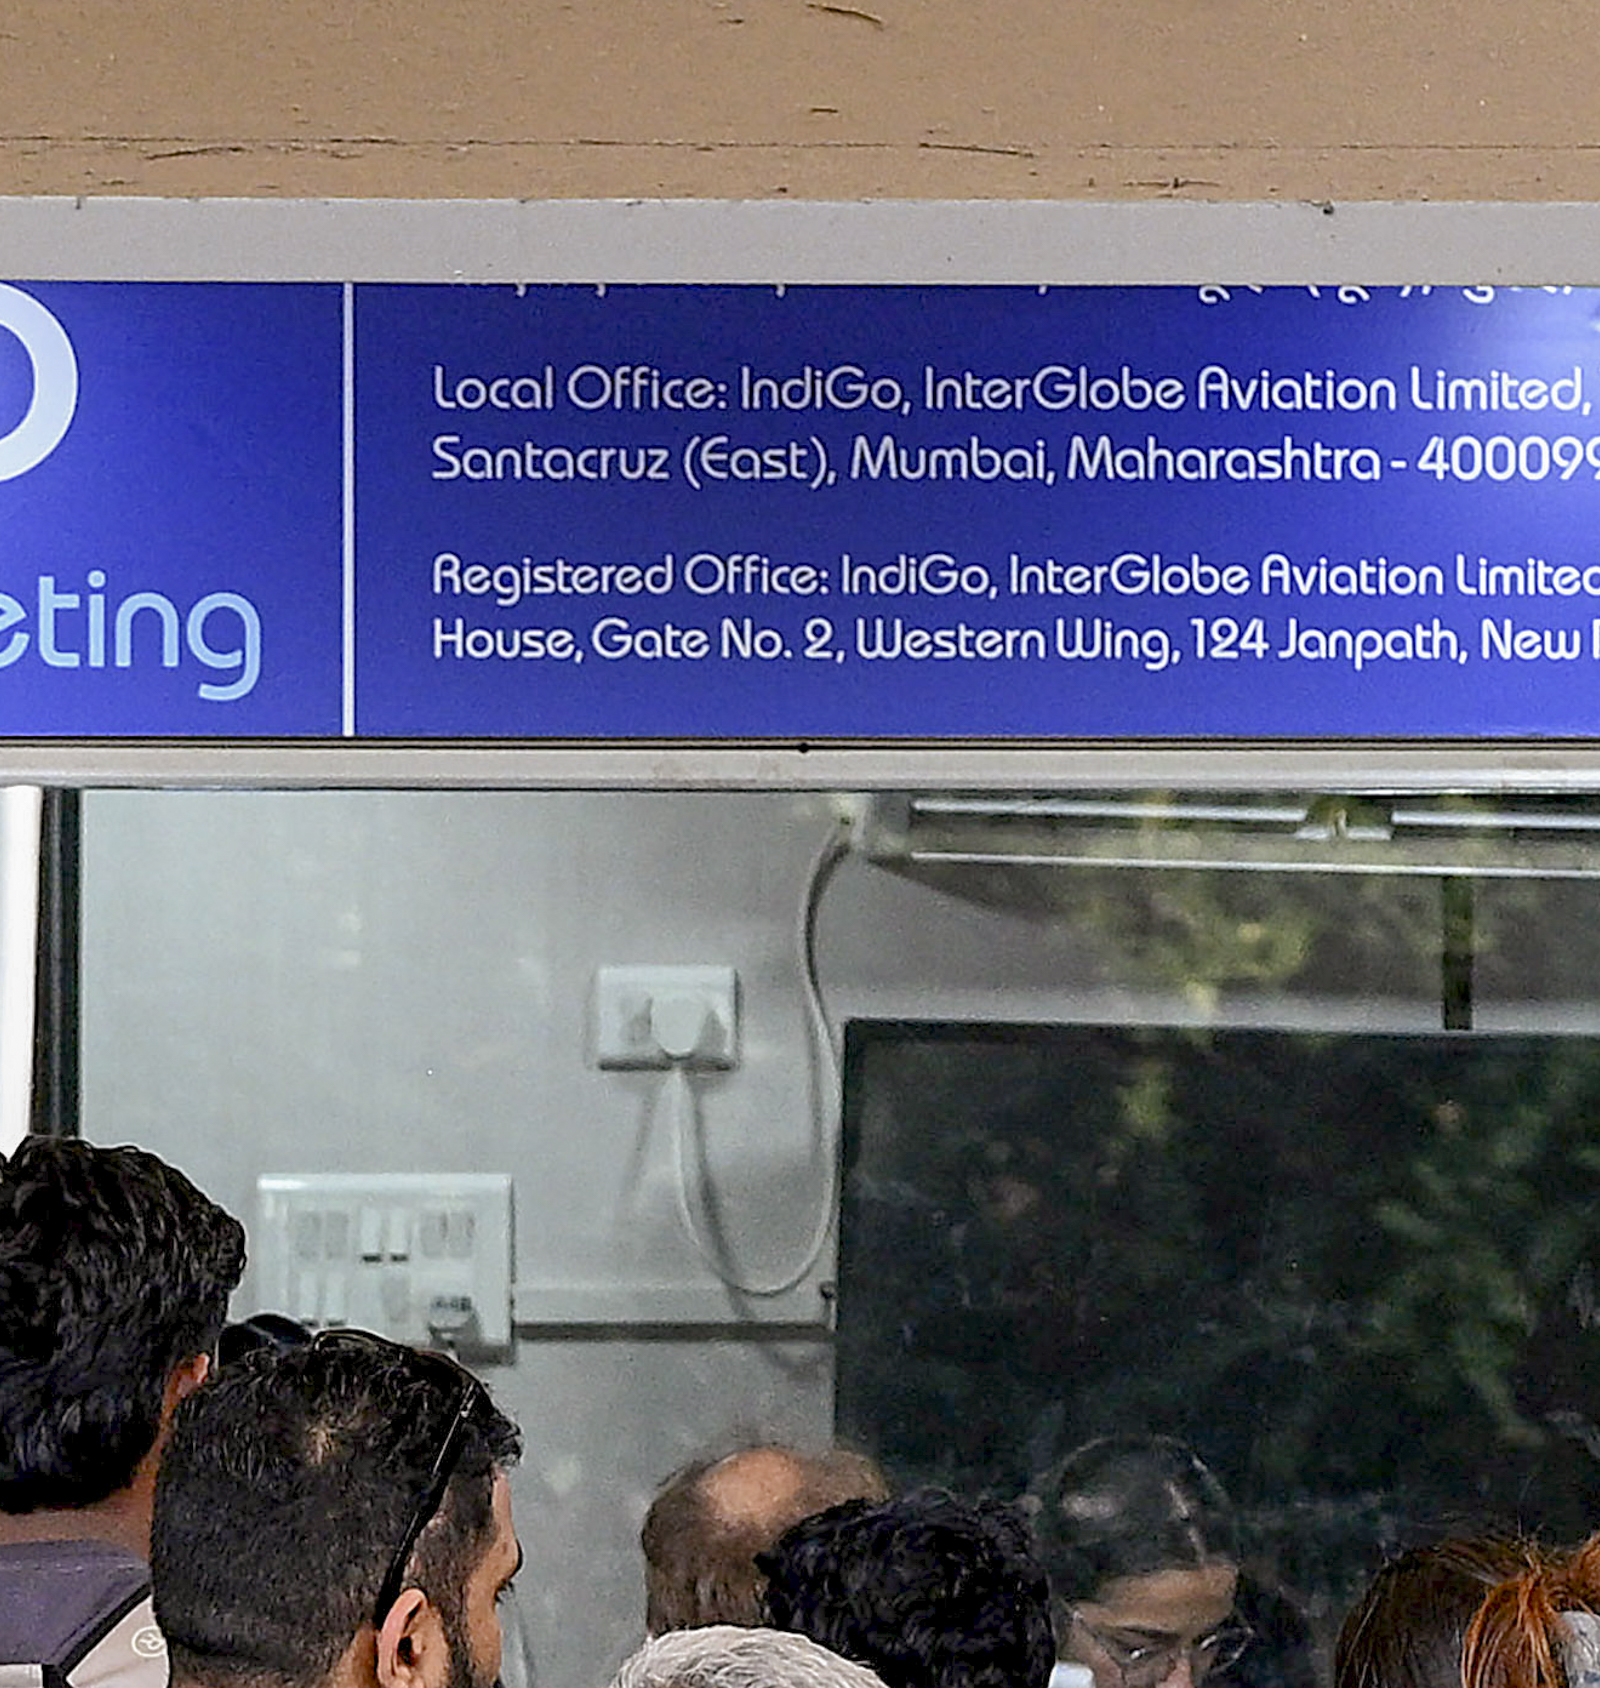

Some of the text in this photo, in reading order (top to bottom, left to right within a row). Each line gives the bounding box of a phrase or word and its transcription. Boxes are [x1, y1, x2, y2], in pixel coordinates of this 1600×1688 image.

[435, 366, 552, 409] Local
[568, 366, 726, 409] Office:
[742, 366, 910, 415] IndiGo,
[926, 366, 1185, 409] InterGlobe
[1199, 366, 1395, 410] Aviation
[1412, 367, 1590, 415] Limited,
[433, 436, 669, 479] Santacruz
[685, 436, 836, 489] (East),
[851, 436, 1054, 485] Mumbai,
[1068, 436, 1380, 480] Maharashtra
[434, 554, 672, 605] Registered
[685, 554, 828, 594] Office:
[843, 554, 997, 599] IndiGo,
[1011, 554, 1250, 595] InterGlobe
[1262, 554, 1443, 595] Aviation
[434, 618, 583, 663] House,
[592, 618, 709, 658] Gate
[722, 618, 792, 658] No.
[805, 618, 844, 663] 2,
[857, 618, 1045, 659] Western
[1057, 618, 1180, 670] Wing,
[1191, 618, 1269, 658] 124
[1278, 618, 1467, 670] Janpath,
[1482, 619, 1580, 659] New
